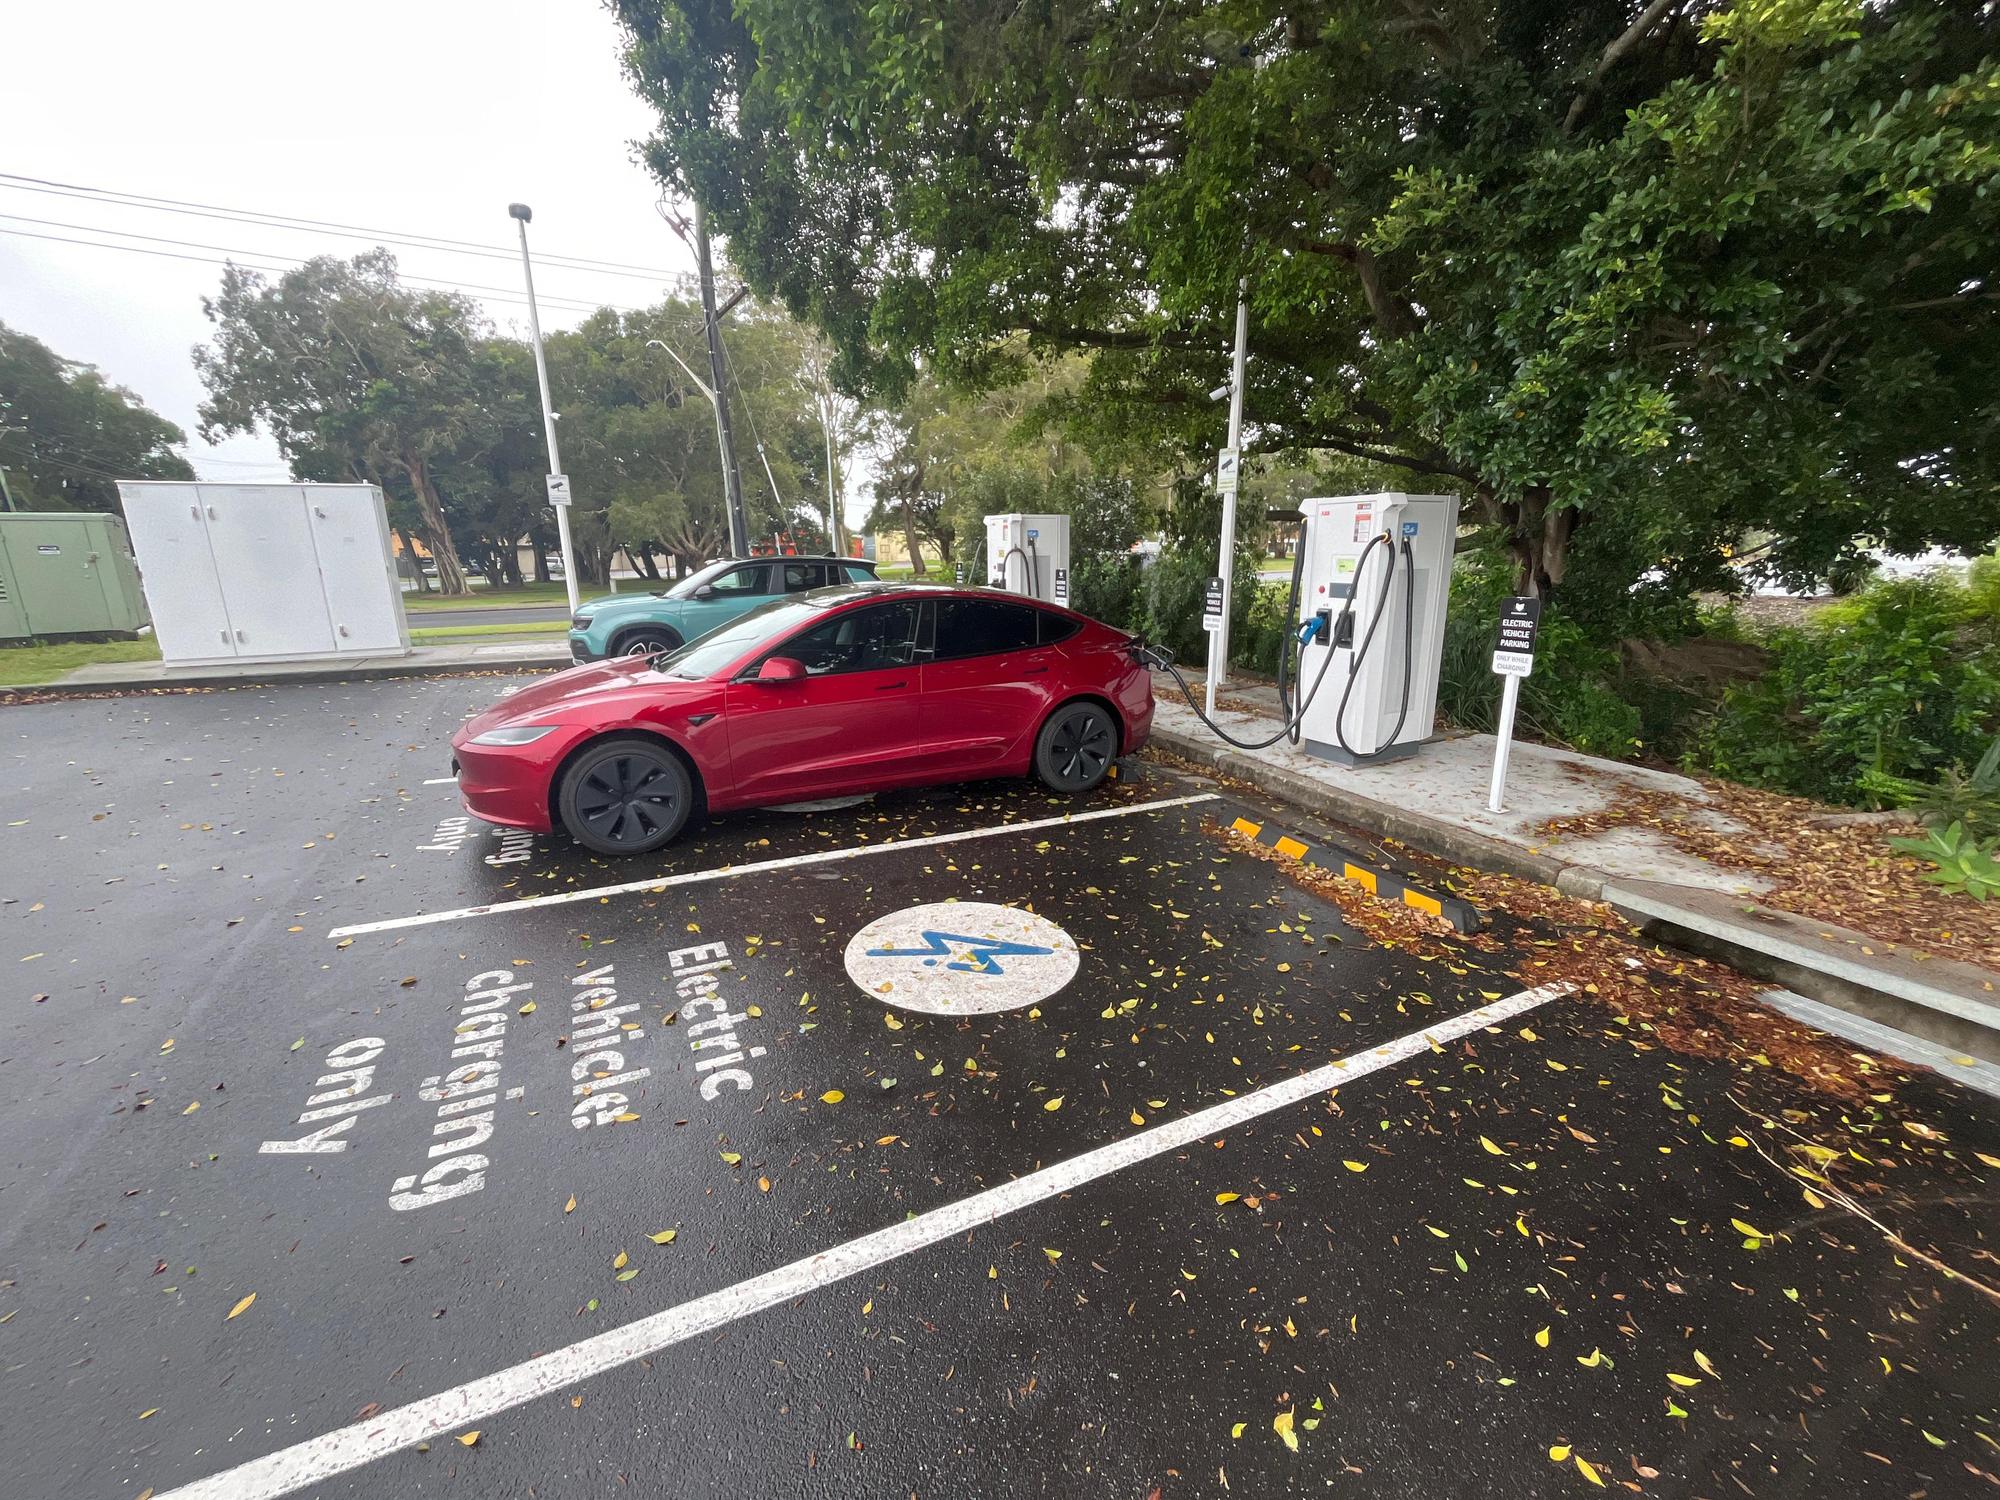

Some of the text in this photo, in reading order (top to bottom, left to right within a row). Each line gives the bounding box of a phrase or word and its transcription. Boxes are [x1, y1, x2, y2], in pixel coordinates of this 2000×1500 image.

[1500, 639, 1530, 649] PARKING
[1502, 618, 1534, 628] ELECTRIC
[1502, 629, 1530, 639] VEHICLE
[416, 817, 479, 850] only
[571, 964, 651, 1129] vehicle
[668, 941, 767, 1101] Electric
[258, 1037, 393, 1153] only
[388, 970, 533, 1211] charging
